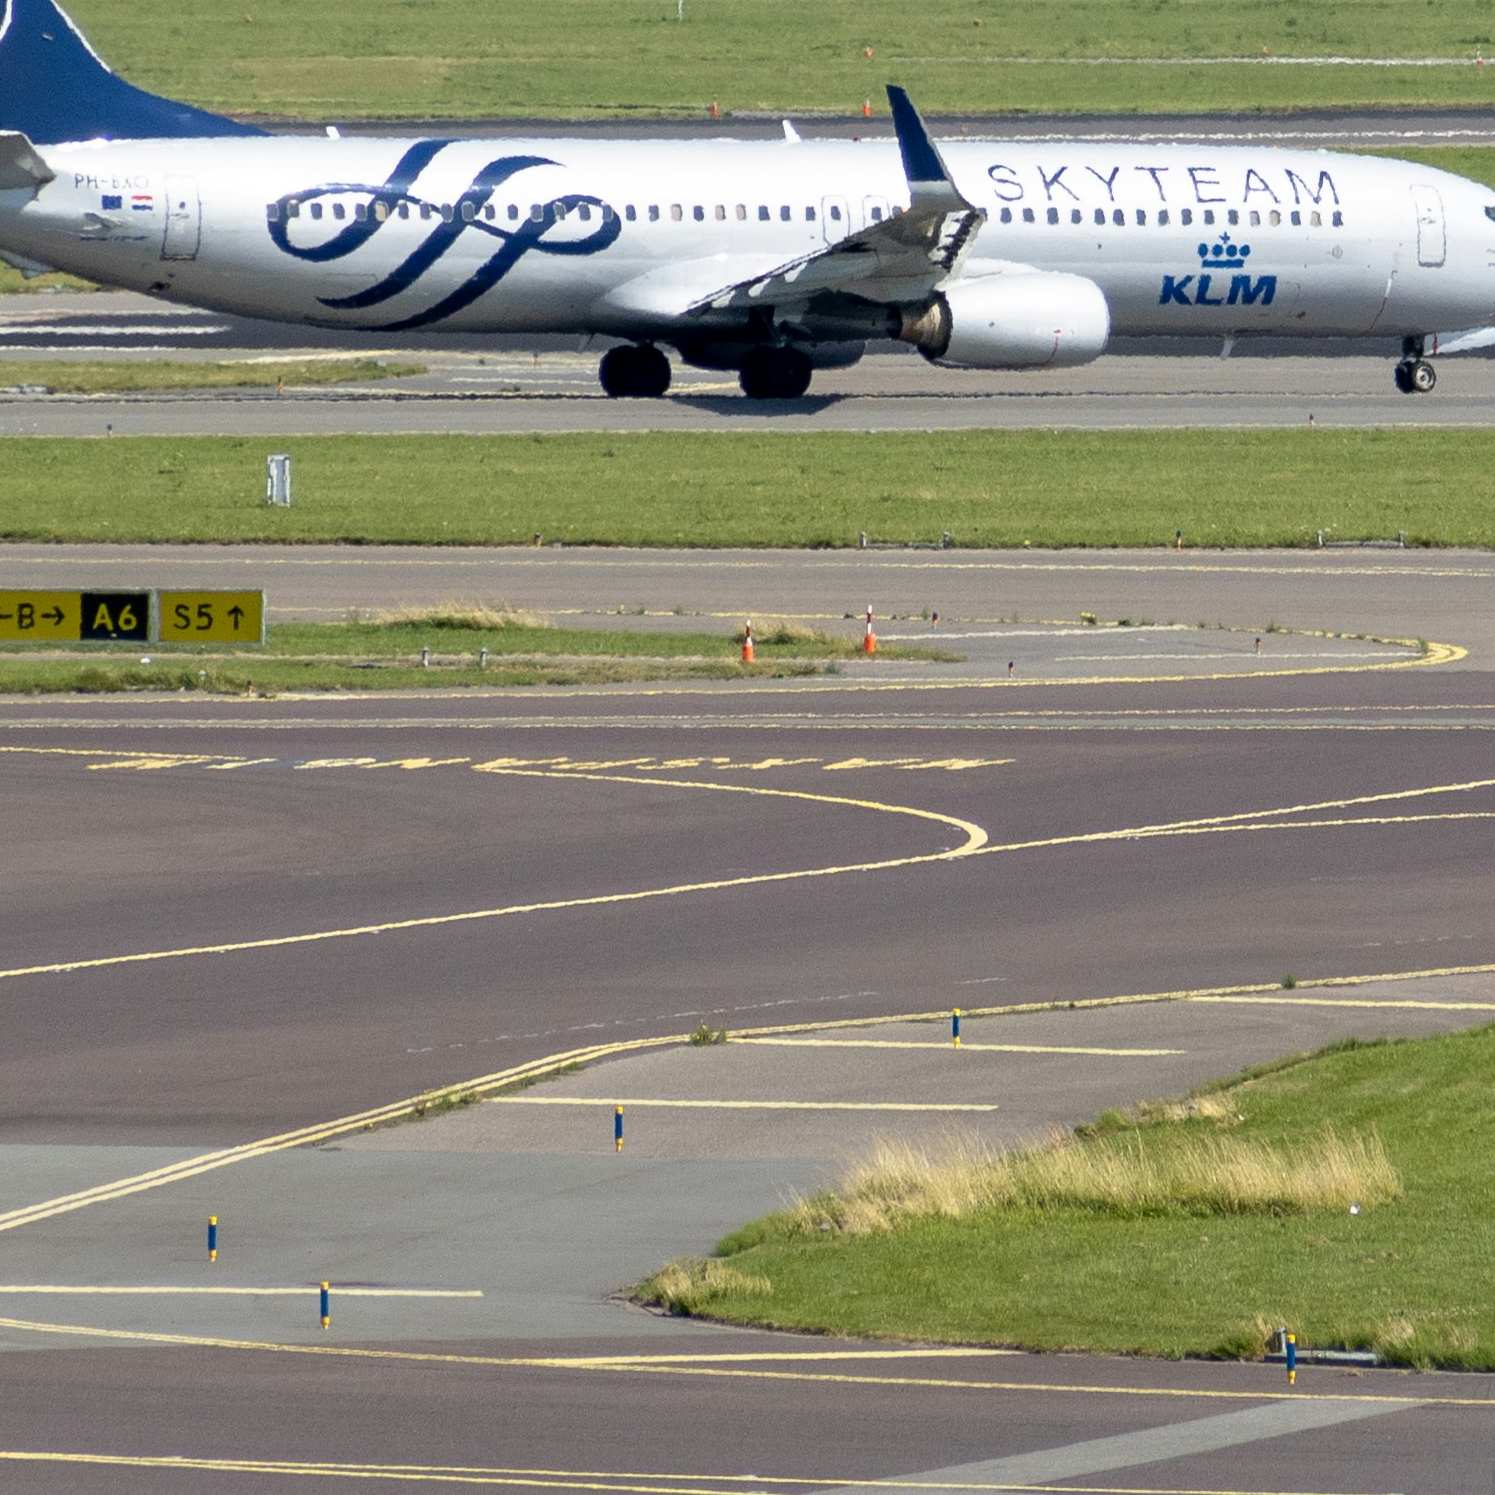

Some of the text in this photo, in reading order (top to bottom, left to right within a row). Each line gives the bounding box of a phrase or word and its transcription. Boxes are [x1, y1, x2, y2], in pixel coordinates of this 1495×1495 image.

[987, 164, 1340, 206] SKYTEAM
[1158, 274, 1277, 306] KLM
[17, 603, 214, 632] B A6 S5
